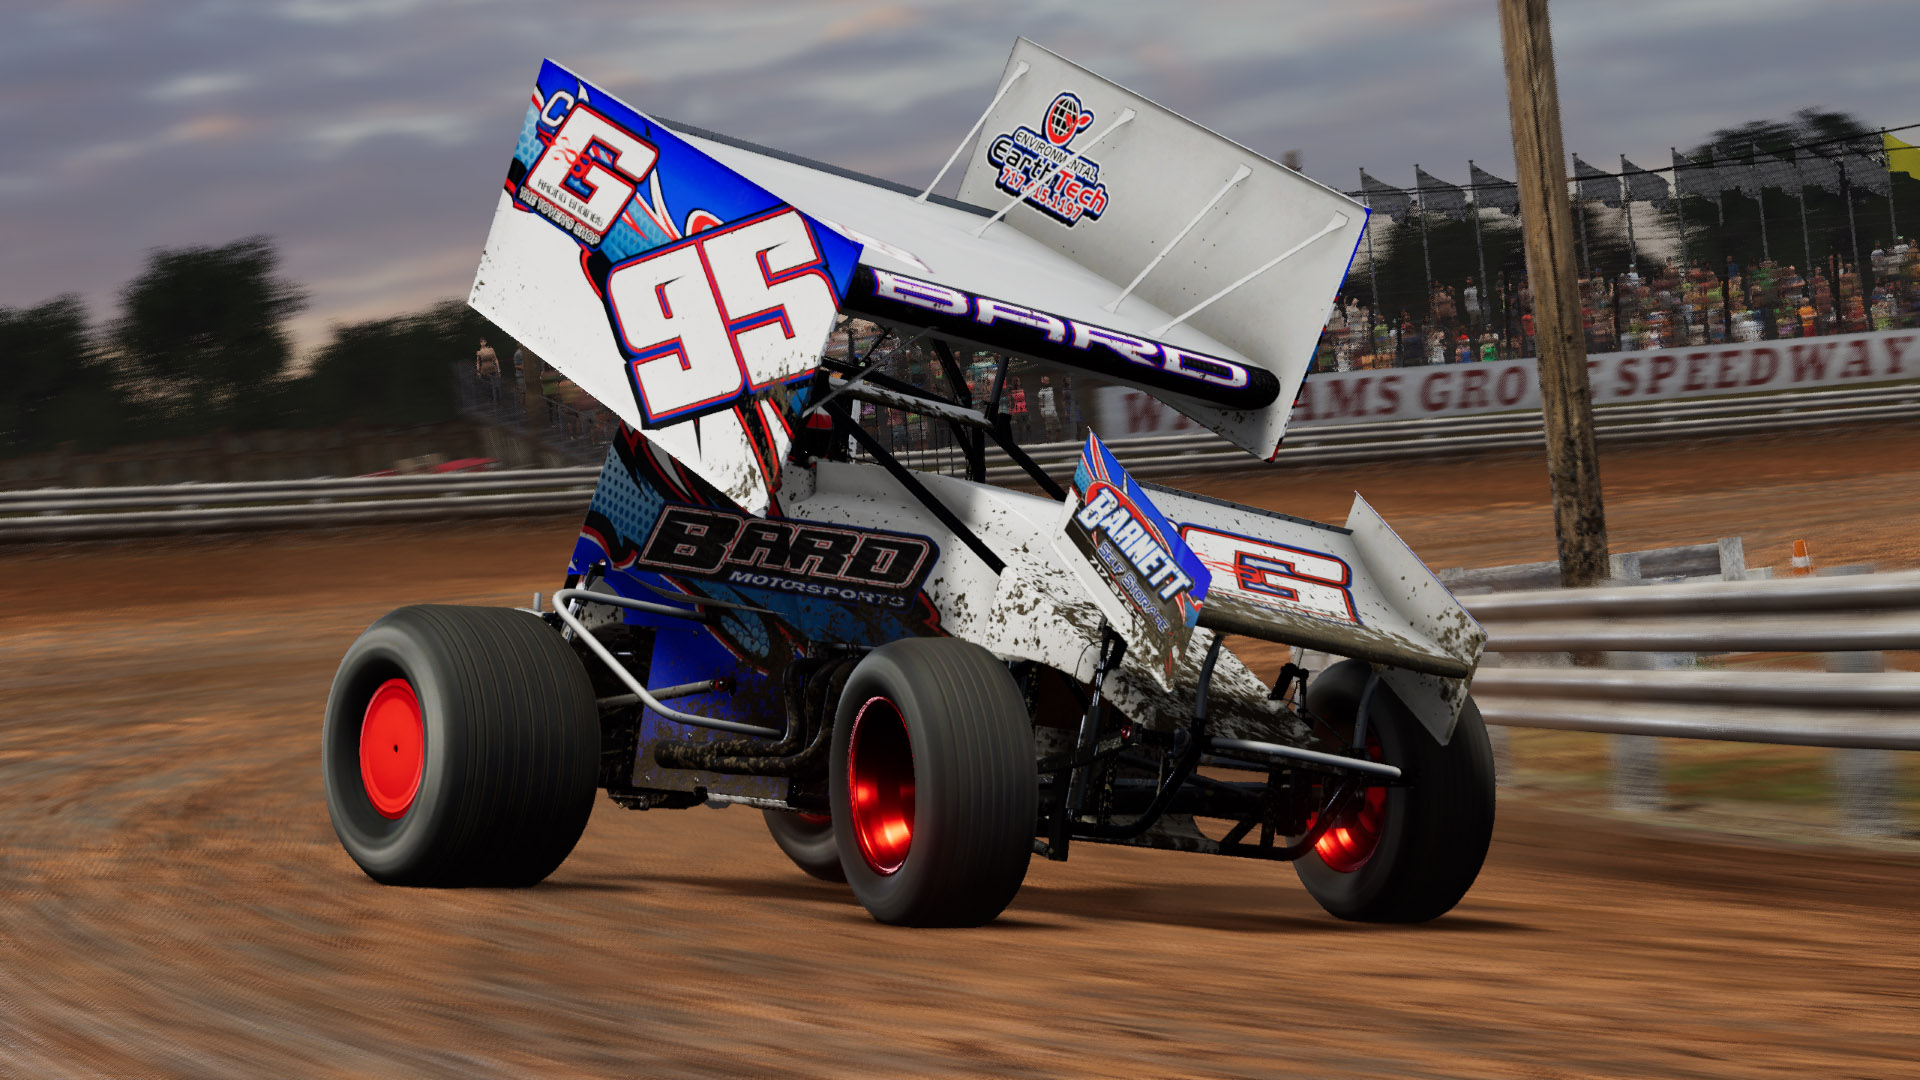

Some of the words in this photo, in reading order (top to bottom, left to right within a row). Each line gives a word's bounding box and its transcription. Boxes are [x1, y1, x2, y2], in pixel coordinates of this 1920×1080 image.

[526, 102, 659, 236] G
[1015, 131, 1097, 181] ENVIRONMNTAL
[519, 186, 538, 207] THE
[573, 222, 601, 246] SHOP
[608, 207, 841, 422] 95
[875, 268, 1250, 389] BARD
[1615, 336, 1914, 398] SPEEDWAY
[639, 505, 930, 589] BARD
[1077, 487, 1194, 601] BARNETT
[728, 570, 905, 607] MOTORSPORTS
